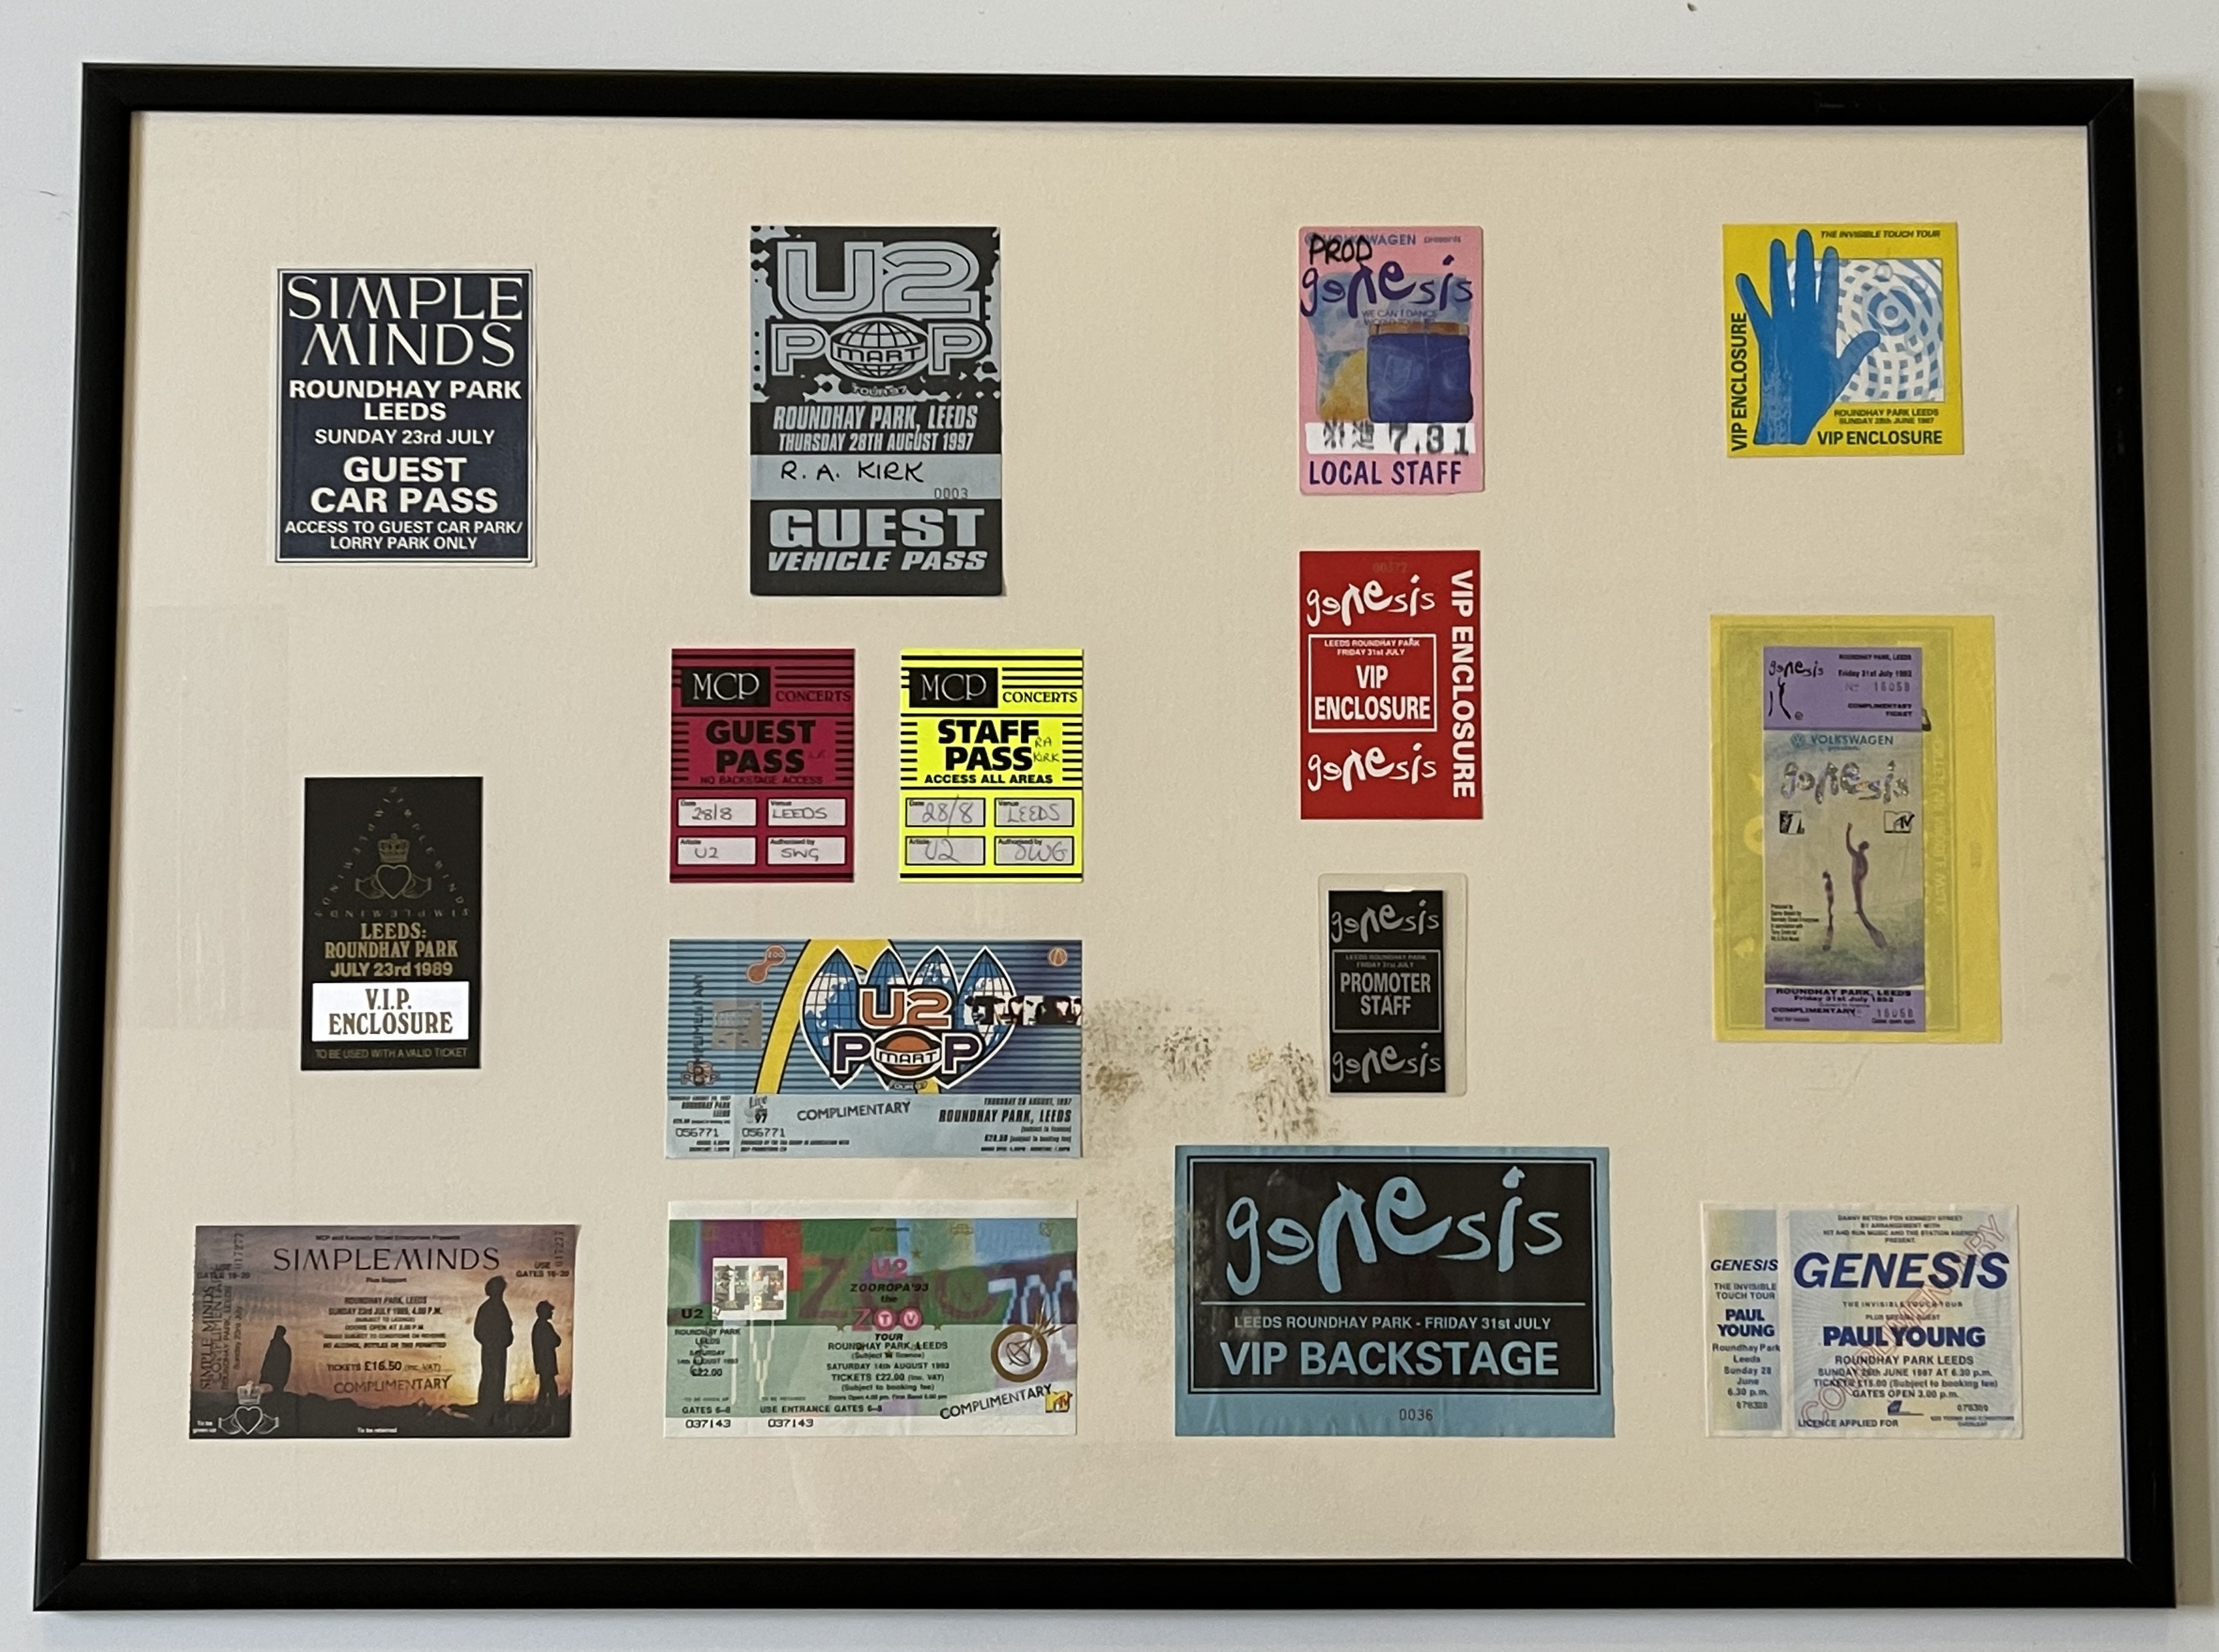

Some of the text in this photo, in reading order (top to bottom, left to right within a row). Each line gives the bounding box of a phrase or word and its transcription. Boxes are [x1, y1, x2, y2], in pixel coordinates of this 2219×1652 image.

[1310, 233, 1372, 265] PROD
[778, 241, 980, 321] U2
[287, 275, 523, 320] SIMPLE
[301, 322, 514, 367] MINDS
[289, 380, 521, 399] ROUNDHAY PARK
[1731, 313, 1747, 452] VIP ENCLOSURE
[364, 402, 446, 420] LEEDS
[774, 405, 978, 432] ROUNDHAY PARK, LEEDS
[315, 429, 494, 445] SUNDAY 23rd JULY
[779, 433, 974, 452] THURSDAY 28TH AUGUST 1997
[1817, 430, 1942, 445] VIP ENCLOSURE
[343, 456, 467, 482] GUEST
[781, 460, 923, 482] R. A. KIRK
[1310, 460, 1461, 485] LOCAL STAFF
[310, 487, 498, 513] CAR PASS
[934, 488, 968, 500] 0003
[285, 521, 523, 534] ACCESS TO GUEST CAR PARK/
[770, 508, 984, 548] GUEST
[331, 537, 477, 550] LORRY PARK ONLY
[769, 551, 988, 570] VEHICLE PASS
[1307, 574, 1435, 627] genesis
[1398, 639, 1420, 647] PARK
[693, 672, 760, 701] MCP
[1356, 665, 1388, 689] VIP
[1451, 570, 1475, 798] VIP ENCLOSURE
[776, 690, 851, 701] CONCERTS
[921, 674, 987, 701] MCP
[1002, 691, 1077, 703] CONCERTS
[1315, 696, 1431, 720] ENCLOSURE
[706, 719, 816, 744] GUEST
[937, 719, 1039, 744] STAFF
[1811, 735, 1893, 745] VOLKSWAGEN
[716, 749, 805, 774] PASS
[945, 746, 1033, 771] PASS
[1034, 752, 1059, 763] KIRK
[1308, 743, 1437, 792] genesis
[700, 776, 823, 784] NO BACKSTAGE ACCESS
[925, 774, 1053, 784] ACCESS ALL AREAS
[772, 808, 827, 819] LEEDS
[1008, 804, 1060, 823] LEEDS
[694, 848, 719, 858] U2
[1331, 899, 1439, 943] genesis
[361, 923, 426, 940] LEEDS:
[325, 941, 458, 959] ROUNDHAY PARK
[331, 962, 454, 977] JULY 23rd 1989
[1340, 972, 1431, 993] PROMOTER
[365, 989, 412, 1009] V.I.P.
[1360, 995, 1411, 1015] STAFF
[859, 988, 952, 1030] U2
[329, 1011, 453, 1035] ENCLOSURE
[315, 1047, 467, 1058] TO BE USED WITH A VALID TICKET
[877, 1051, 937, 1064] MART
[1332, 1042, 1441, 1084] genesis
[796, 1101, 911, 1122] COMPLIMENTARY
[939, 1110, 1070, 1124] ROUNDHAY PARK, LEEDS
[676, 1128, 719, 1136] 056771
[742, 1128, 785, 1137] 056771
[1226, 1165, 1563, 1296] genesis
[871, 1259, 907, 1279] U2
[1711, 1259, 1779, 1271] GENESIS
[1794, 1251, 2010, 1289] GENESIS
[1734, 1283, 1777, 1291] INVISIBLE
[881, 1295, 897, 1303] the
[682, 1309, 703, 1319] U2
[1235, 1316, 1551, 1331] LEEDS ROUNDHAY PARK FRIDAY 31st JULY
[1726, 1309, 1765, 1321] PAUL
[201, 1286, 214, 1389] SIMPLE MINDS
[1717, 1324, 1775, 1337] YOUNG
[1823, 1327, 1985, 1347] PAUL YOUNG
[1713, 1343, 1758, 1352] Roundhay
[1219, 1341, 1559, 1375] VIP BACKSTAGE
[1835, 1355, 1973, 1365] ROUNDHAY PARK LEEDS
[334, 1375, 452, 1393] COMPLIMENTARY
[939, 1383, 1053, 1420] COMPLIMENTARY
[686, 1420, 731, 1428] 037143
[768, 1419, 814, 1427] 037143
[1399, 1409, 1433, 1422] 0036
